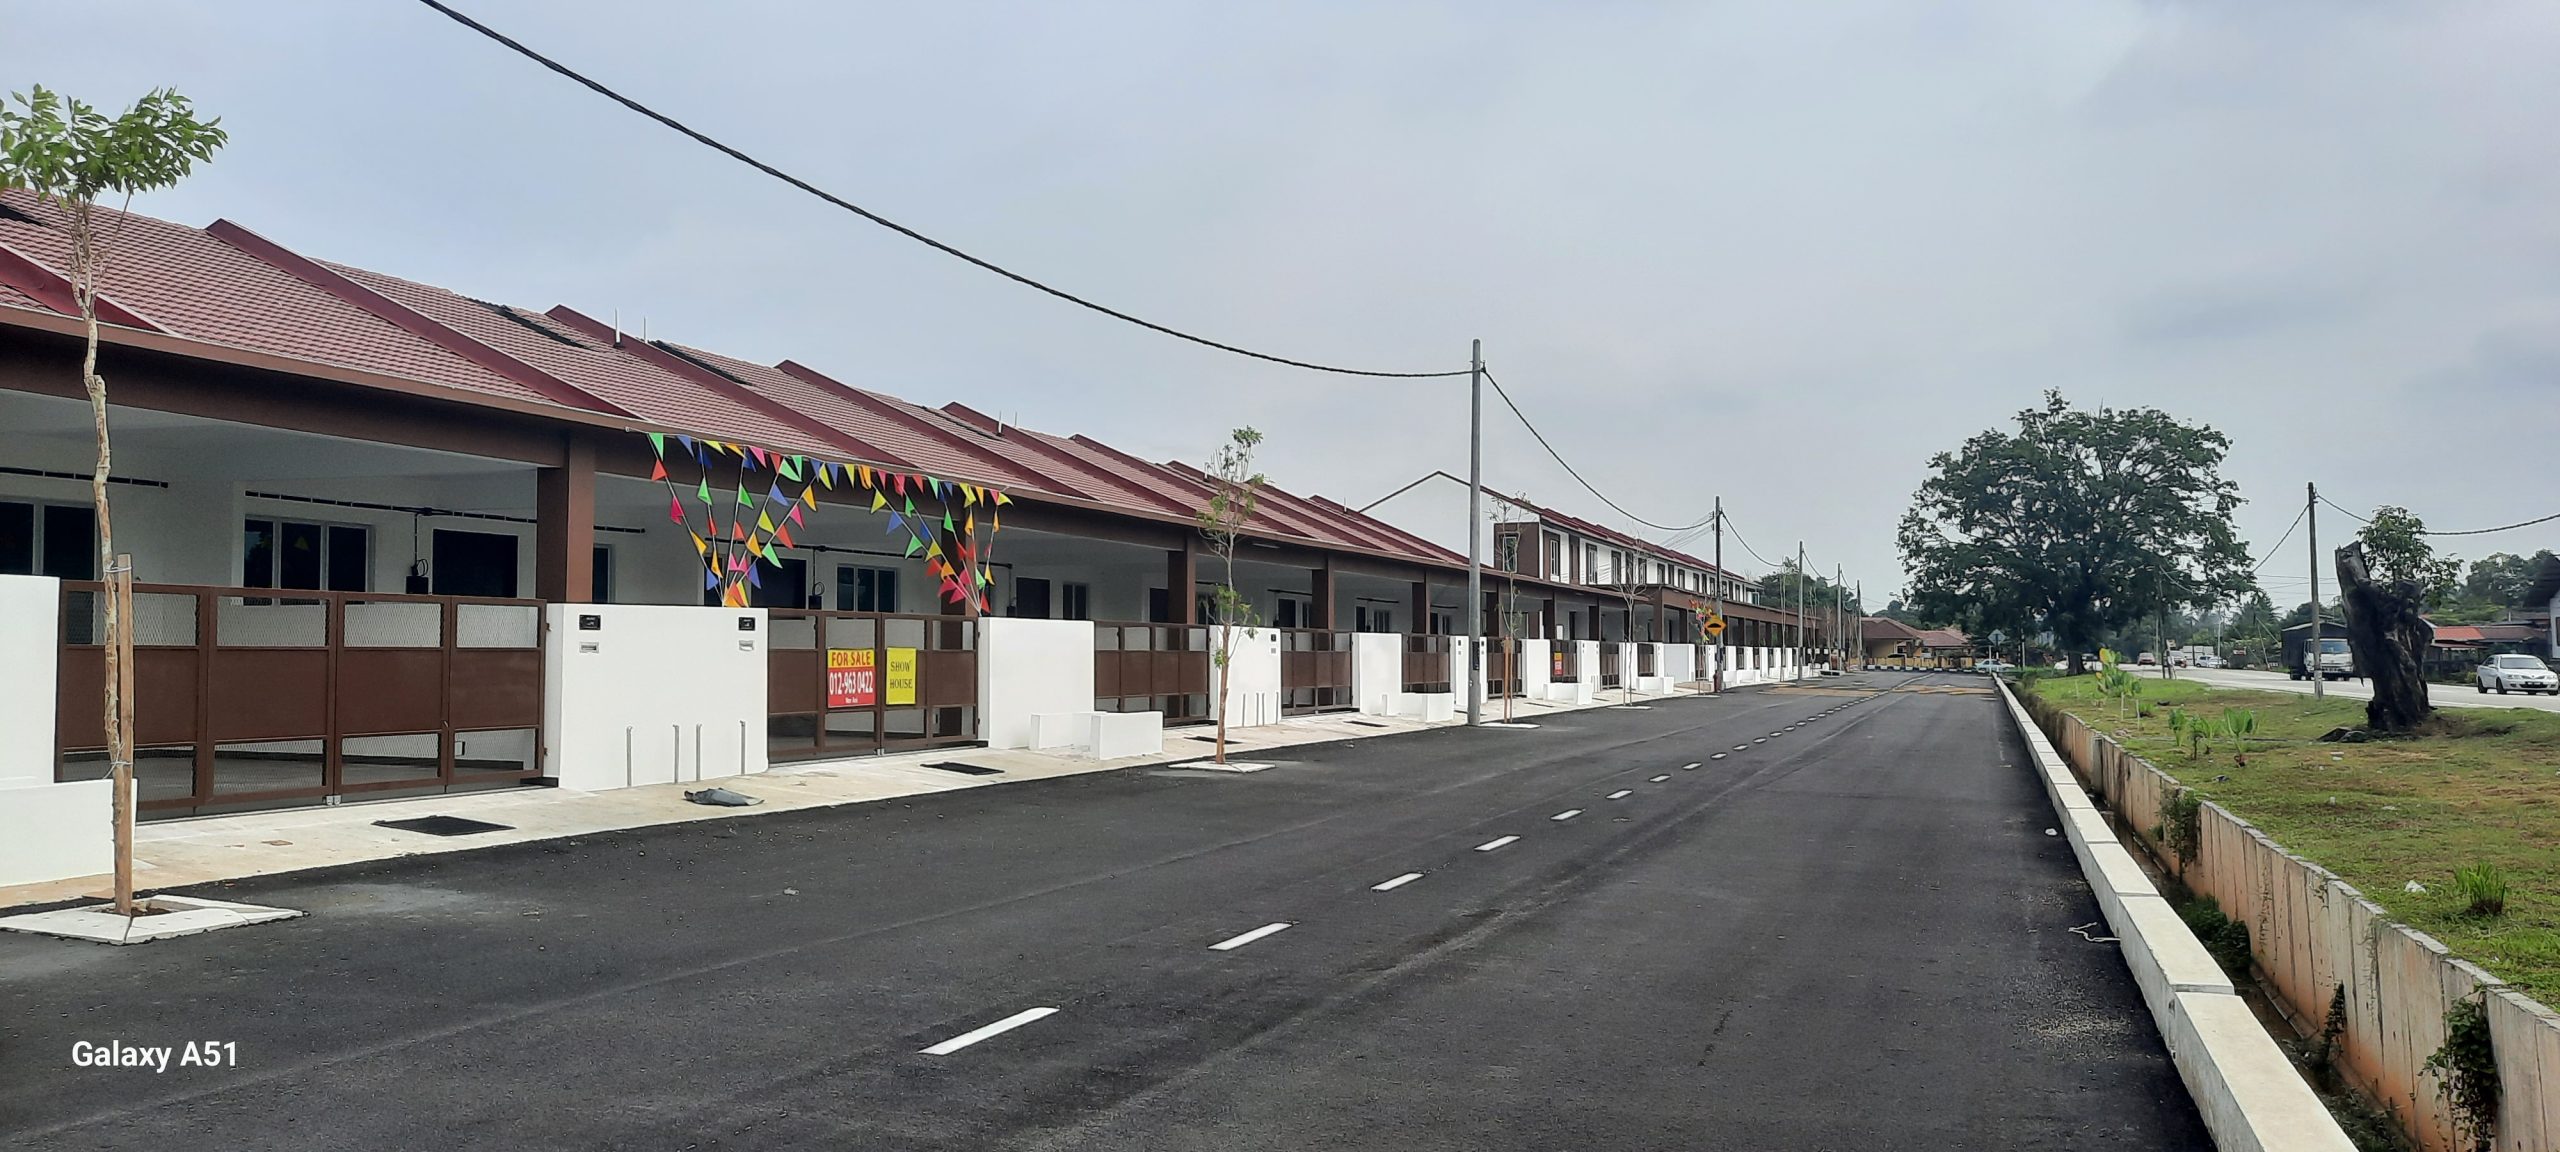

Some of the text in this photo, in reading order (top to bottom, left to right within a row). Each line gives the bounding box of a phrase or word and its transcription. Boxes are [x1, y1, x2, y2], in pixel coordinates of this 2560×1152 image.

[831, 651, 871, 667] FOR SALE
[890, 660, 911, 672] SHOW
[889, 678, 913, 689] HOUSE
